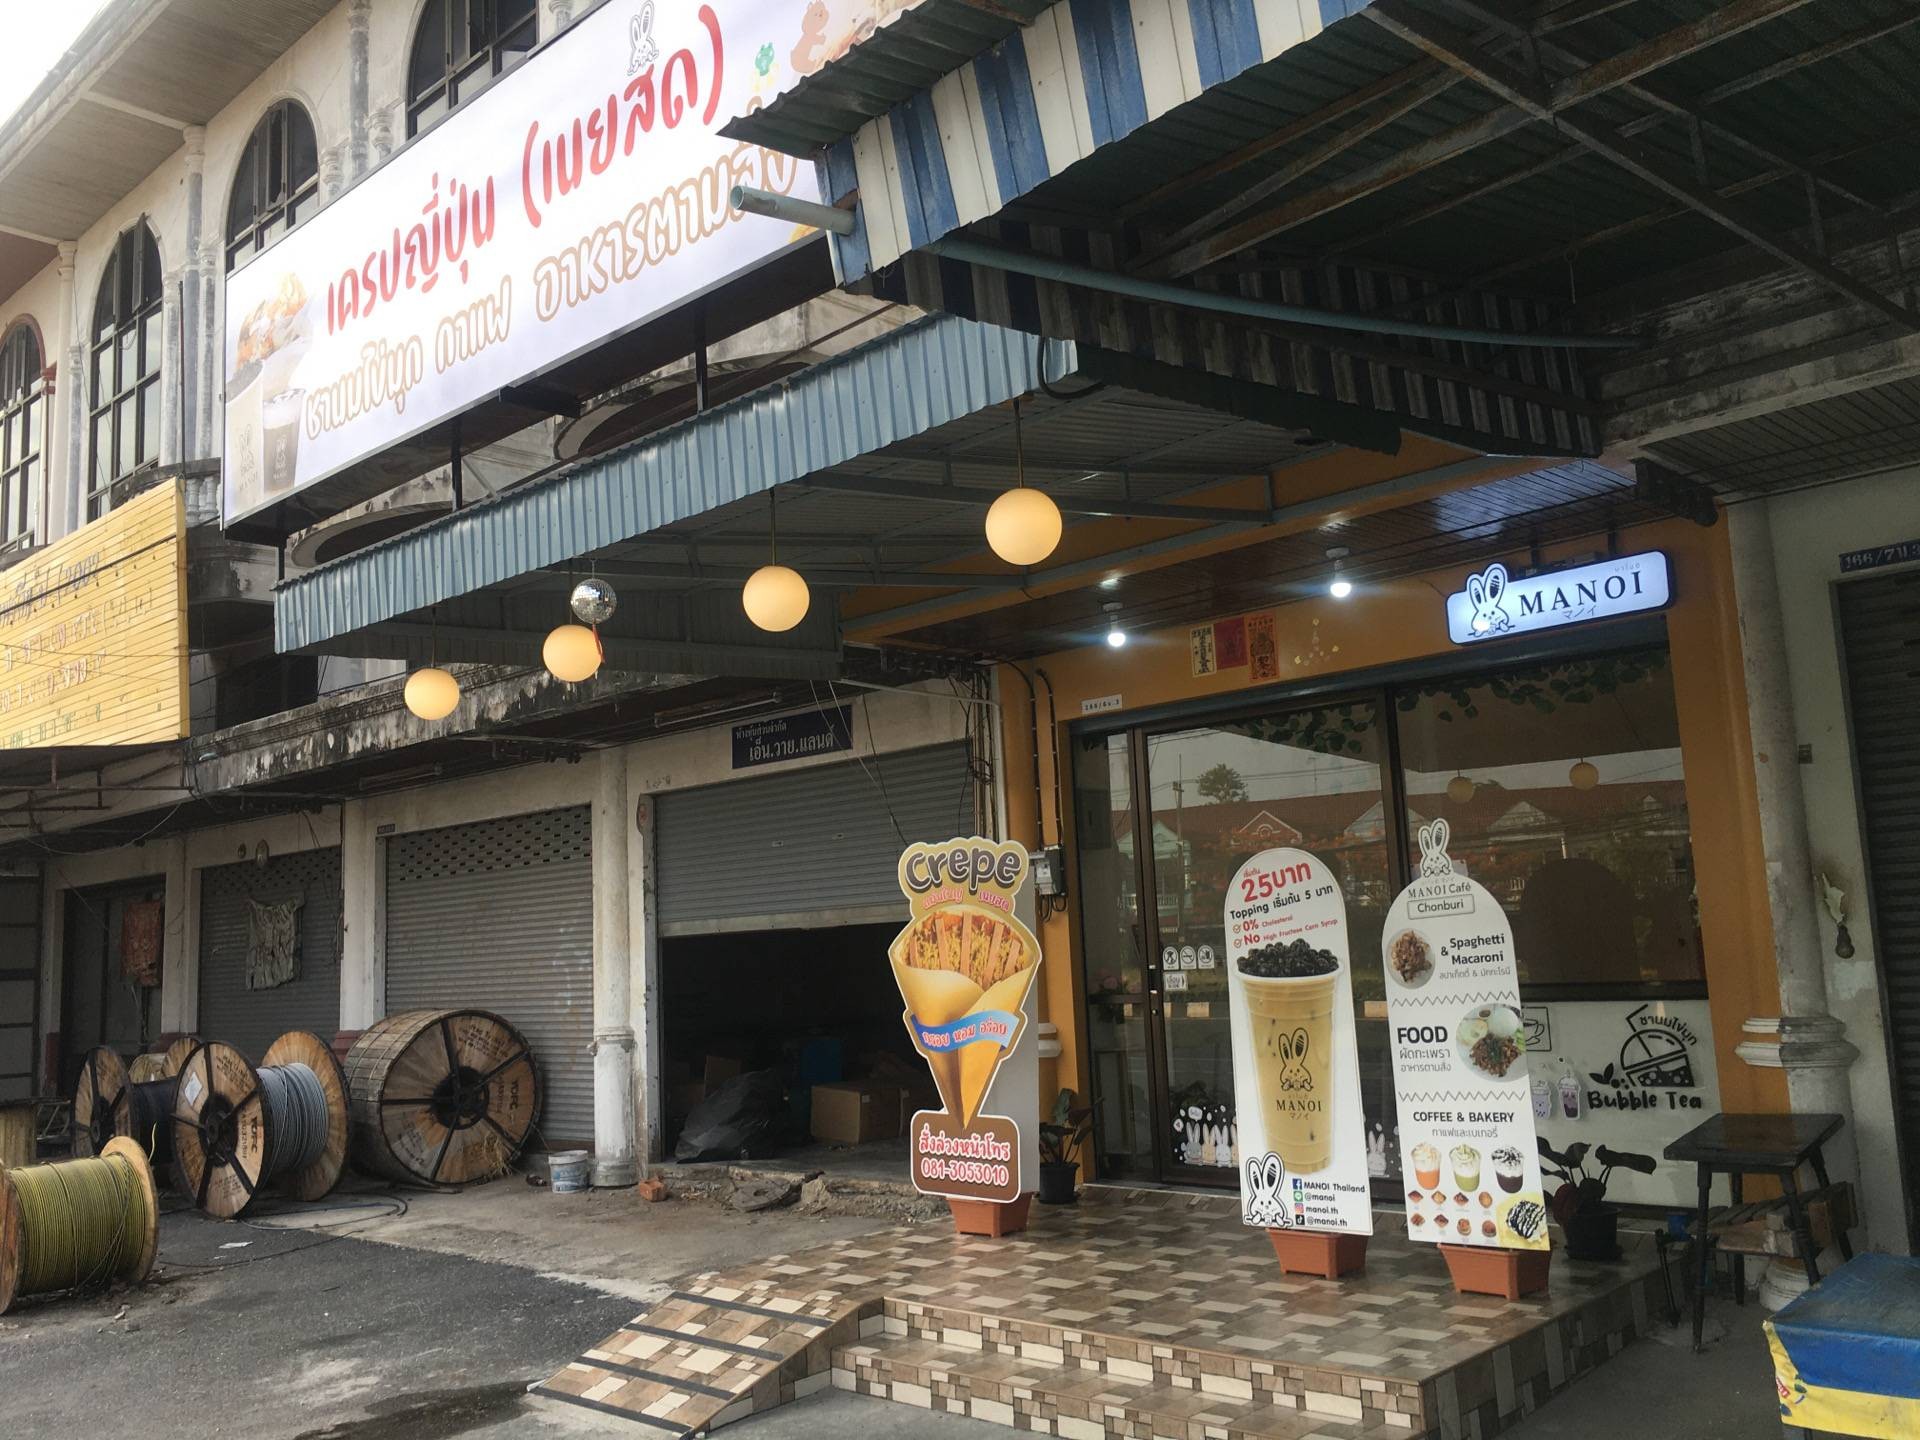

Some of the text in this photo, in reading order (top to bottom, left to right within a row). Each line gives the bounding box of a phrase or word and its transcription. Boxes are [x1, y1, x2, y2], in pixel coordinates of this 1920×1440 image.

[327, 4, 724, 337] เครปญี่ปุ่น (เนยสด)
[435, 274, 512, 375] กาแฟ
[533, 95, 797, 322] อาหารตามสง
[1518, 570, 1644, 617] MANOI
[904, 846, 1022, 895] Crepe
[1240, 862, 1312, 903] 25บาท
[1408, 884, 1446, 899] MANOI
[1230, 902, 1270, 920] Topping
[1305, 890, 1312, 901] 5
[1315, 885, 1334, 897] บาท
[1417, 898, 1464, 913] Chonburi
[1242, 919, 1260, 932] 0%
[1243, 933, 1261, 946] No
[1304, 922, 1319, 932] Corn
[1320, 917, 1339, 929] Syrup
[1449, 933, 1506, 951] Spaghetti
[1440, 945, 1505, 966] & Macaroni
[1397, 1025, 1448, 1045] FOOD
[1639, 1015, 1698, 1047] ชานมไข่มุก
[1276, 1099, 1322, 1112] MANOI
[1587, 1090, 1702, 1111] Bubble Tea
[1413, 1111, 1515, 1123] COFFEE & BAKERY
[920, 1157, 1010, 1187] 081-3053010
[1303, 1181, 1366, 1193] MANOI Thailand
[1304, 1191, 1336, 1202] @manoi
[1306, 1206, 1339, 1215] manoi.th
[1307, 1216, 1348, 1227] @manoi.th
